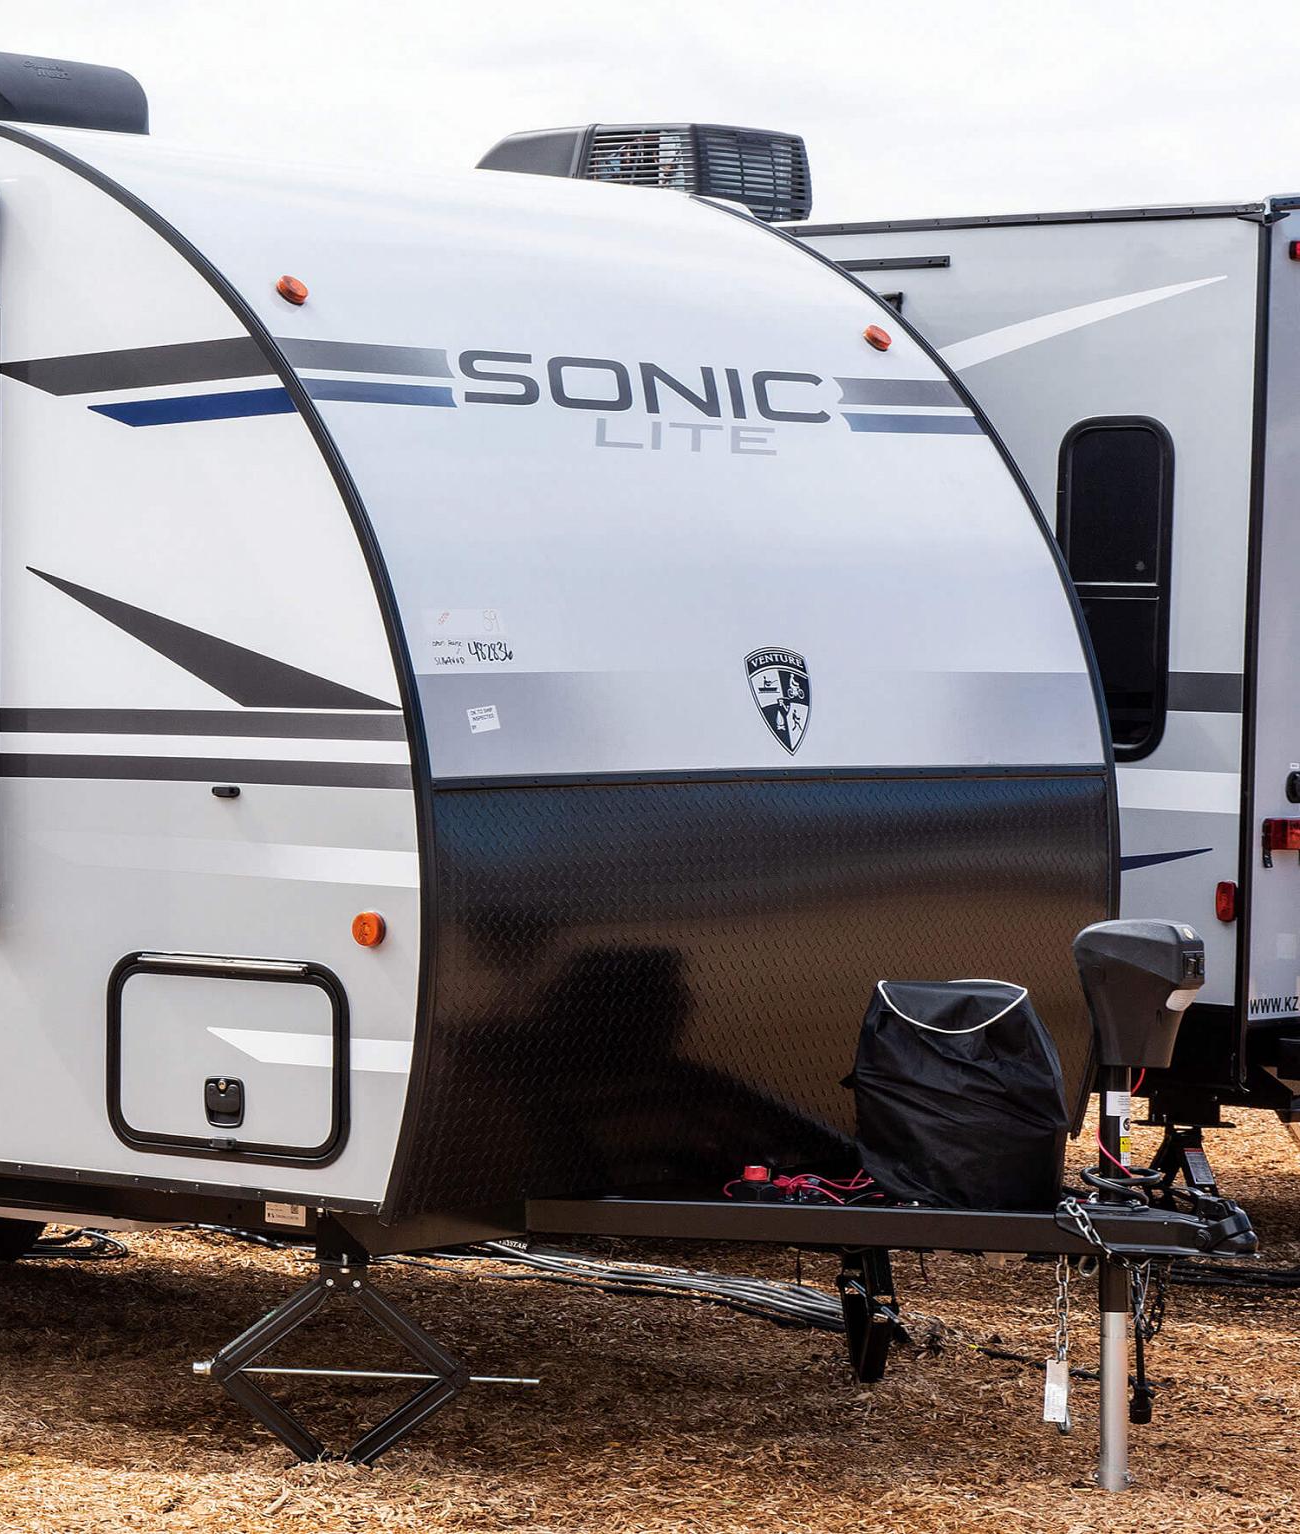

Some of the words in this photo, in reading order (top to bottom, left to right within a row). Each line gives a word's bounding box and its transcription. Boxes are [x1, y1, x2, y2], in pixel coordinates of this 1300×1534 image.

[458, 349, 831, 424] SONIC
[595, 417, 777, 456] LITE
[751, 653, 804, 669] VENTURE
